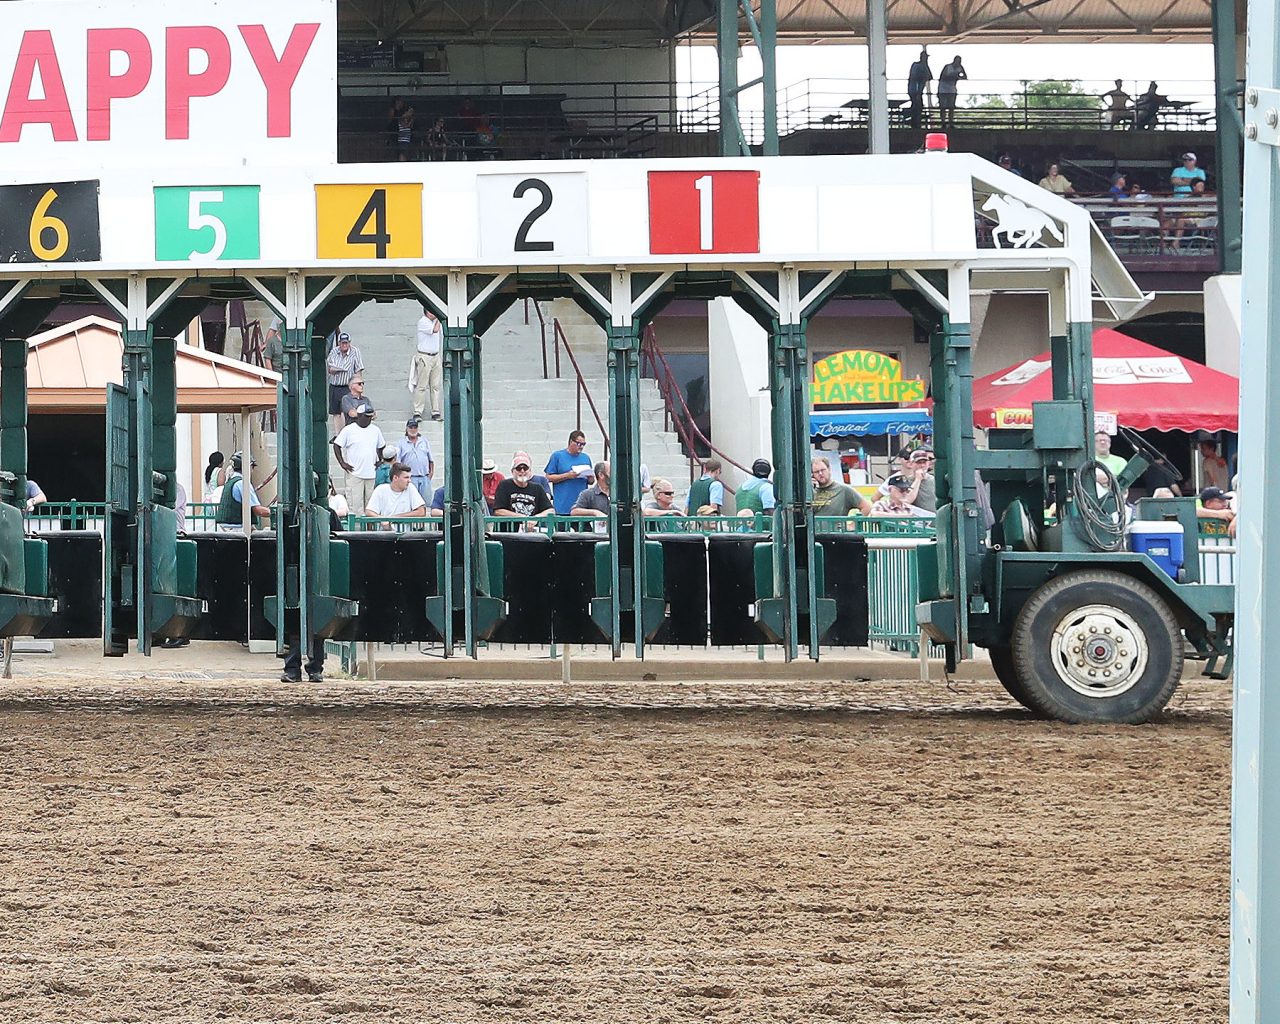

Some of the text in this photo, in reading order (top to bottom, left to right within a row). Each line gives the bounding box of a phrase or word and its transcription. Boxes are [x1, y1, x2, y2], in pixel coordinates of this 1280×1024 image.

[29, 188, 70, 261] 6
[187, 191, 228, 261] 5
[347, 189, 391, 259] 4
[513, 178, 555, 252] 2
[693, 175, 715, 251] 1
[810, 381, 876, 403] HAKE
[816, 352, 900, 383] LEMON
[819, 422, 871, 434] Tropical
